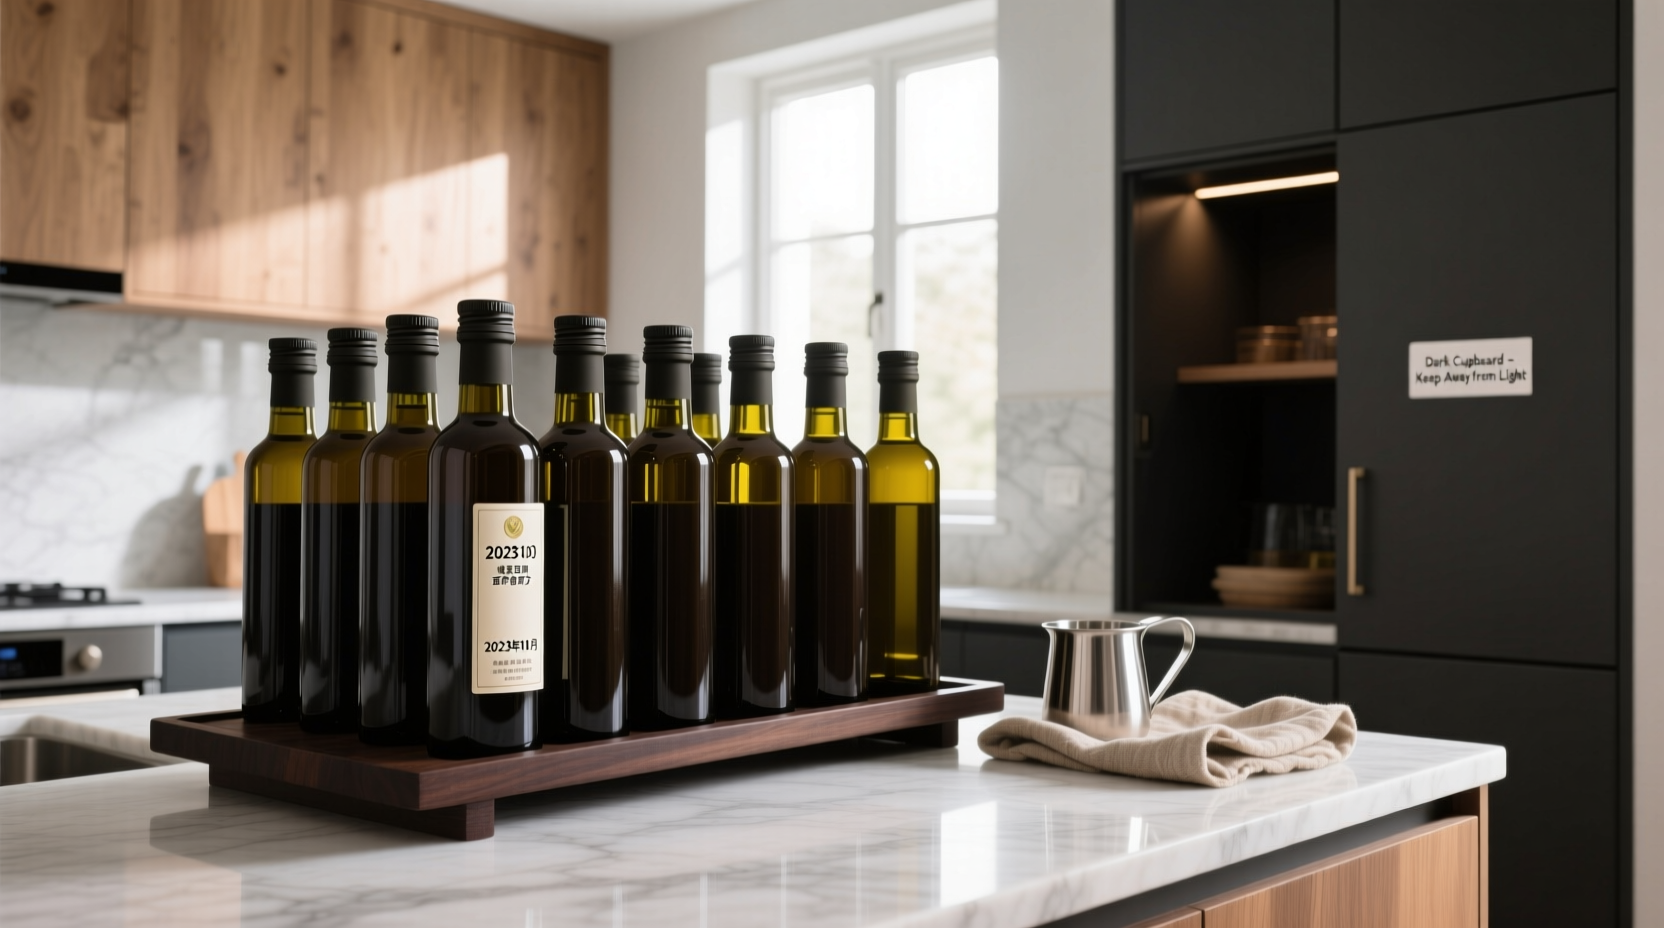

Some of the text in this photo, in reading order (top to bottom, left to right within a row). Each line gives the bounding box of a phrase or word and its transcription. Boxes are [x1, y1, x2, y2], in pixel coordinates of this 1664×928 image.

[1425, 354, 1450, 368] Dark
[1415, 371, 1441, 387] Keep
[1443, 371, 1470, 386] Away
[1499, 368, 1527, 384] Light
